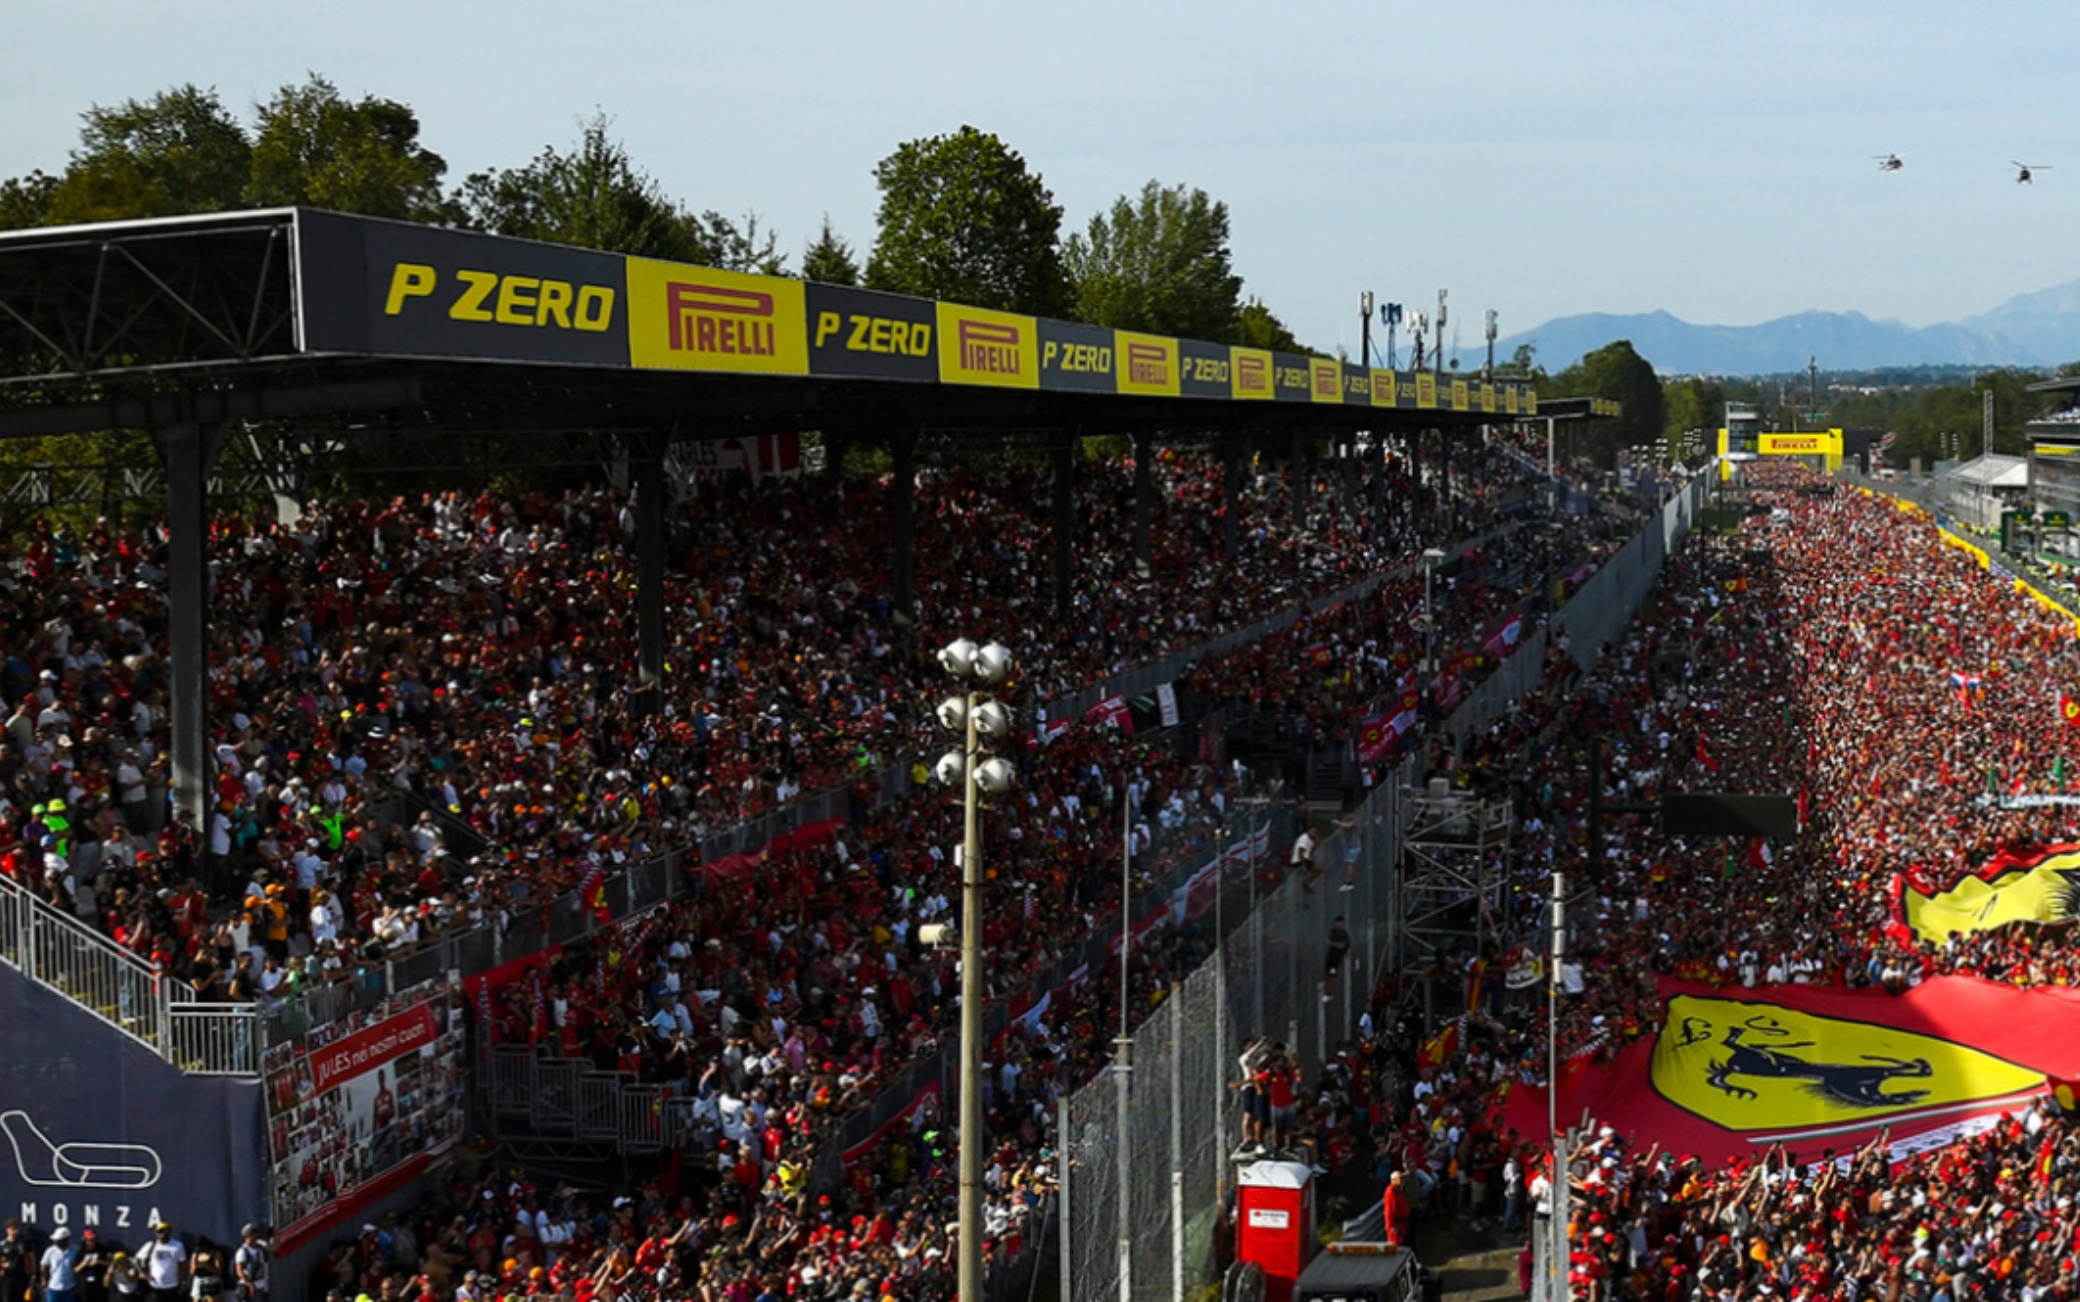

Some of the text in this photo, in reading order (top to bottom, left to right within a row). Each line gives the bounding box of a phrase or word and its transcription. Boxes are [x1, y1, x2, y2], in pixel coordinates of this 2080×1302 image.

[385, 262, 615, 333] P ZERO
[667, 281, 774, 357] PIRELLI
[816, 311, 932, 357] P ZERO
[959, 318, 1020, 374] PIRELLI
[1043, 341, 1111, 374] P ZERO
[1128, 342, 1168, 385] PIRELLI
[1182, 357, 1229, 382] P ZERO
[318, 1051, 351, 1087] JULES
[21, 1201, 164, 1229] MONZA
